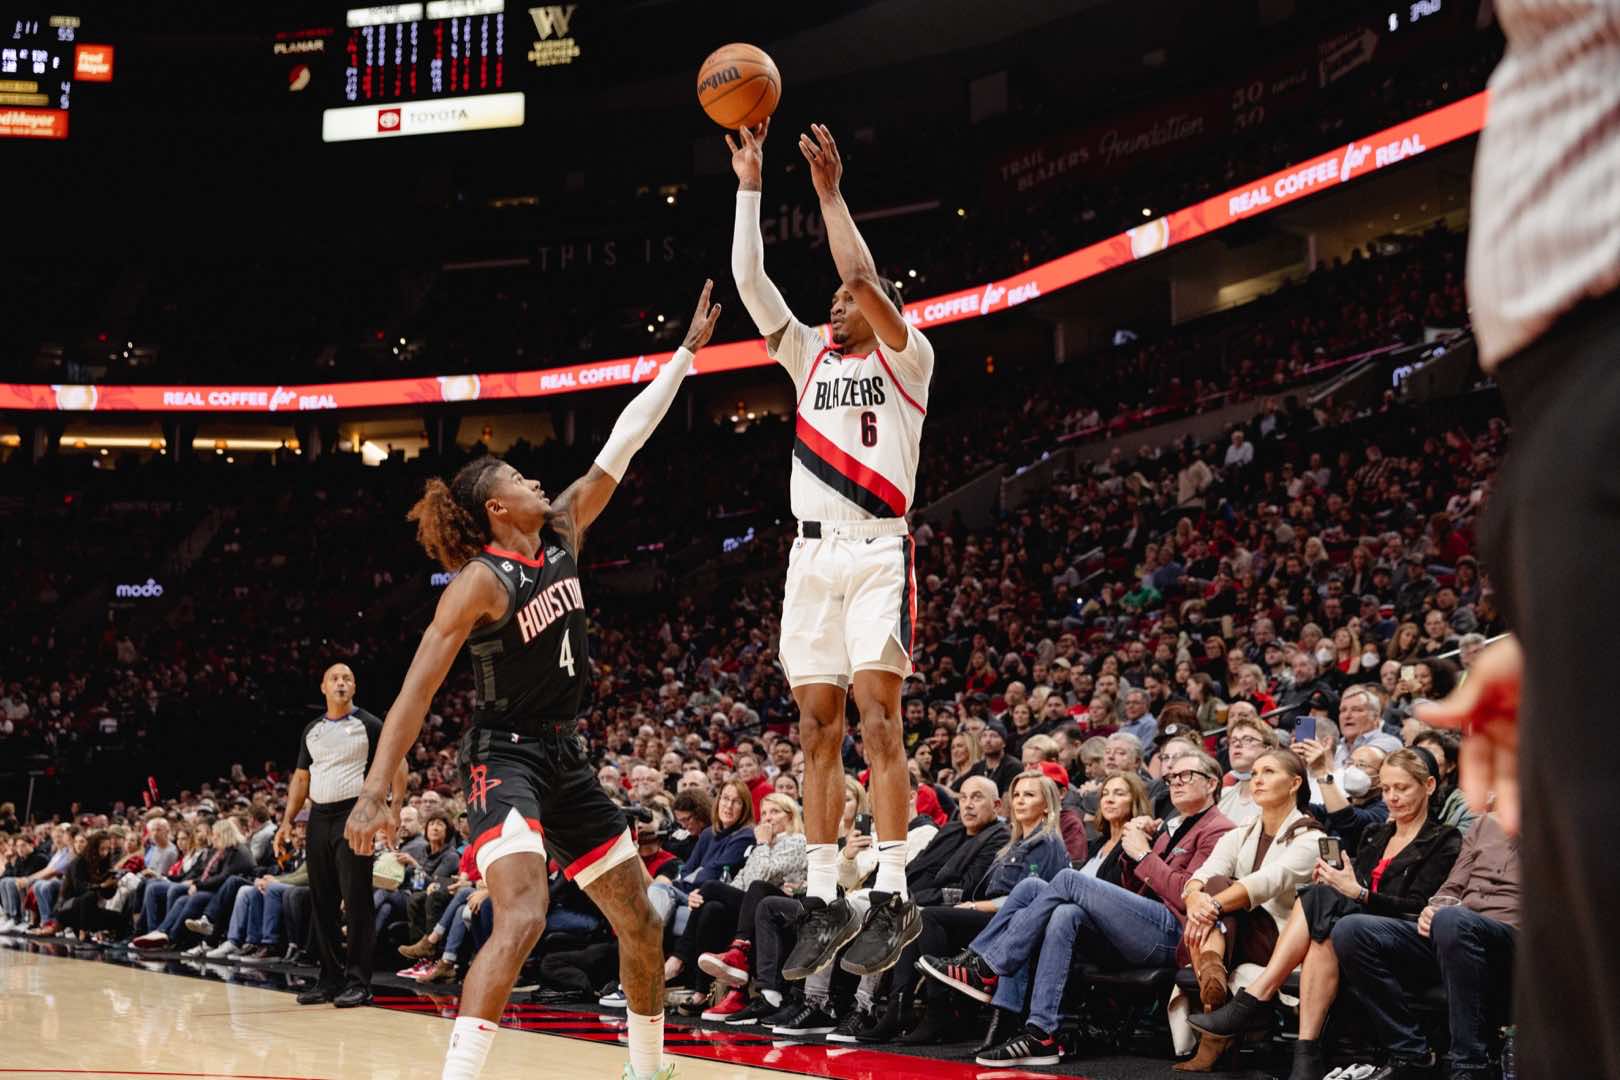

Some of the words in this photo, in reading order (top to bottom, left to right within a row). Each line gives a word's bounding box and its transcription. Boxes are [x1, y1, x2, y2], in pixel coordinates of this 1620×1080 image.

[410, 109, 468, 123] TOYOTA
[1228, 185, 1273, 217] REAL
[1273, 157, 1340, 199] COFFEE
[1340, 142, 1373, 183] for
[1375, 133, 1427, 169] REAL
[536, 240, 617, 273] THIS
[645, 235, 675, 264] IS
[924, 293, 980, 322] COFFEE
[980, 283, 1007, 315] for
[1007, 280, 1042, 307] REAL
[540, 372, 577, 390] REAL
[578, 364, 632, 385] COFFEE
[631, 355, 658, 384] for
[163, 391, 205, 406] REAL
[207, 391, 268, 406] COFFEE
[269, 386, 297, 411] for
[299, 394, 338, 410] REAL
[814, 376, 886, 411] BLAZERS
[860, 411, 878, 448] 6
[501, 560, 514, 573] 6
[559, 627, 576, 678] 4
